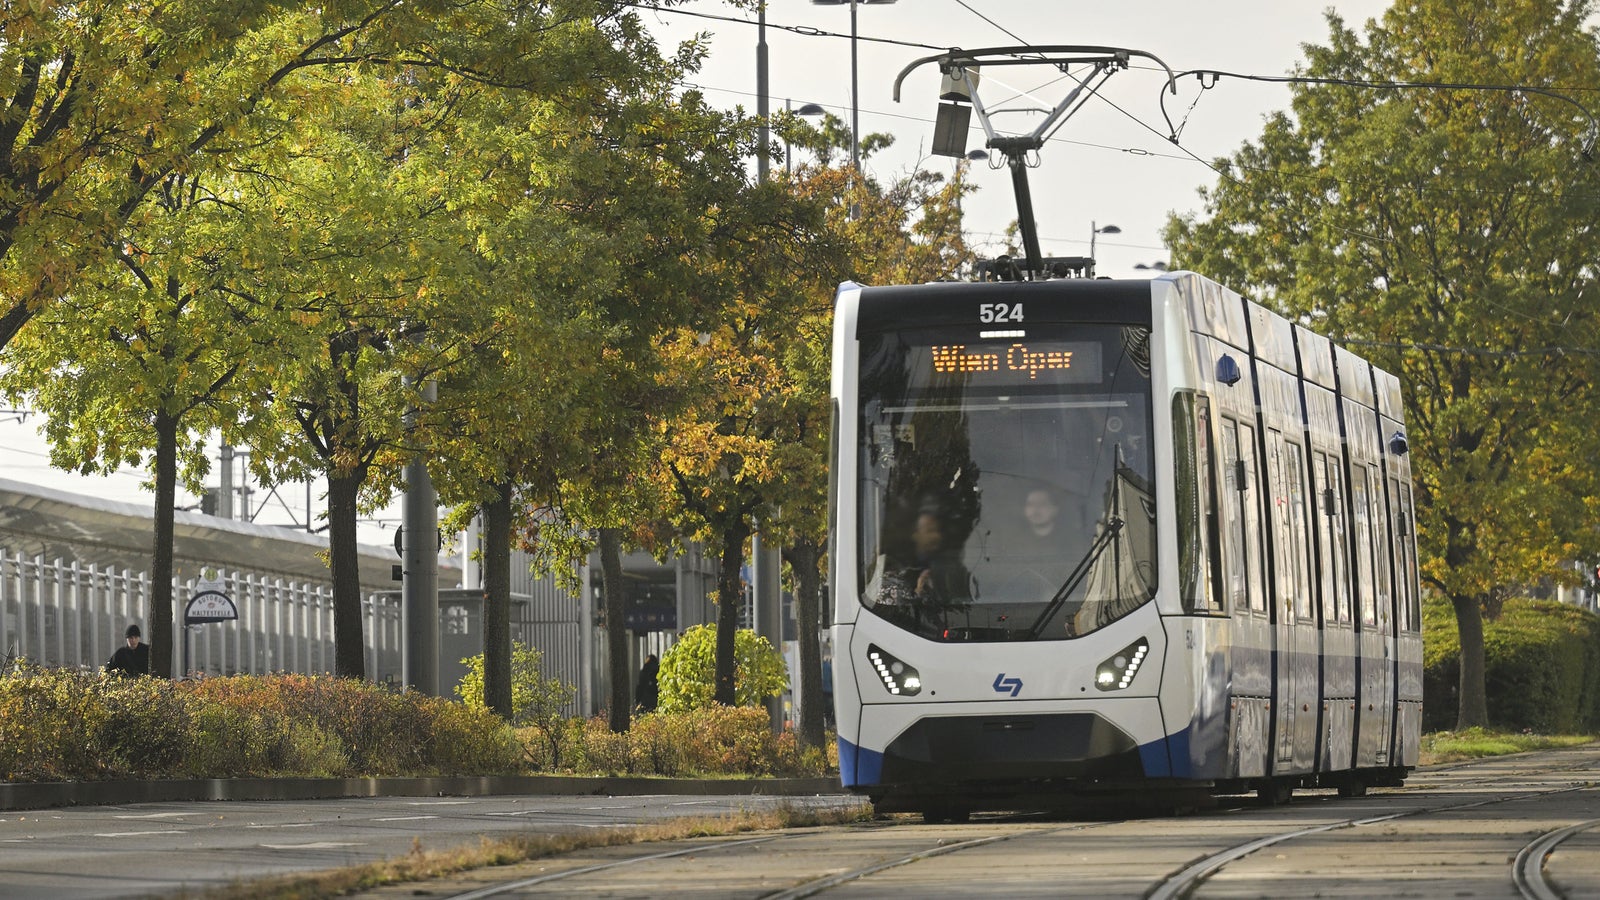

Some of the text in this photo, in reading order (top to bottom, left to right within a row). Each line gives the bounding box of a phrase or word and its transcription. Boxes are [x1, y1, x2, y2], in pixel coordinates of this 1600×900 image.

[980, 303, 1025, 323] 524
[932, 343, 1073, 379] Wien Oper
[198, 595, 227, 606] AUTOBUS
